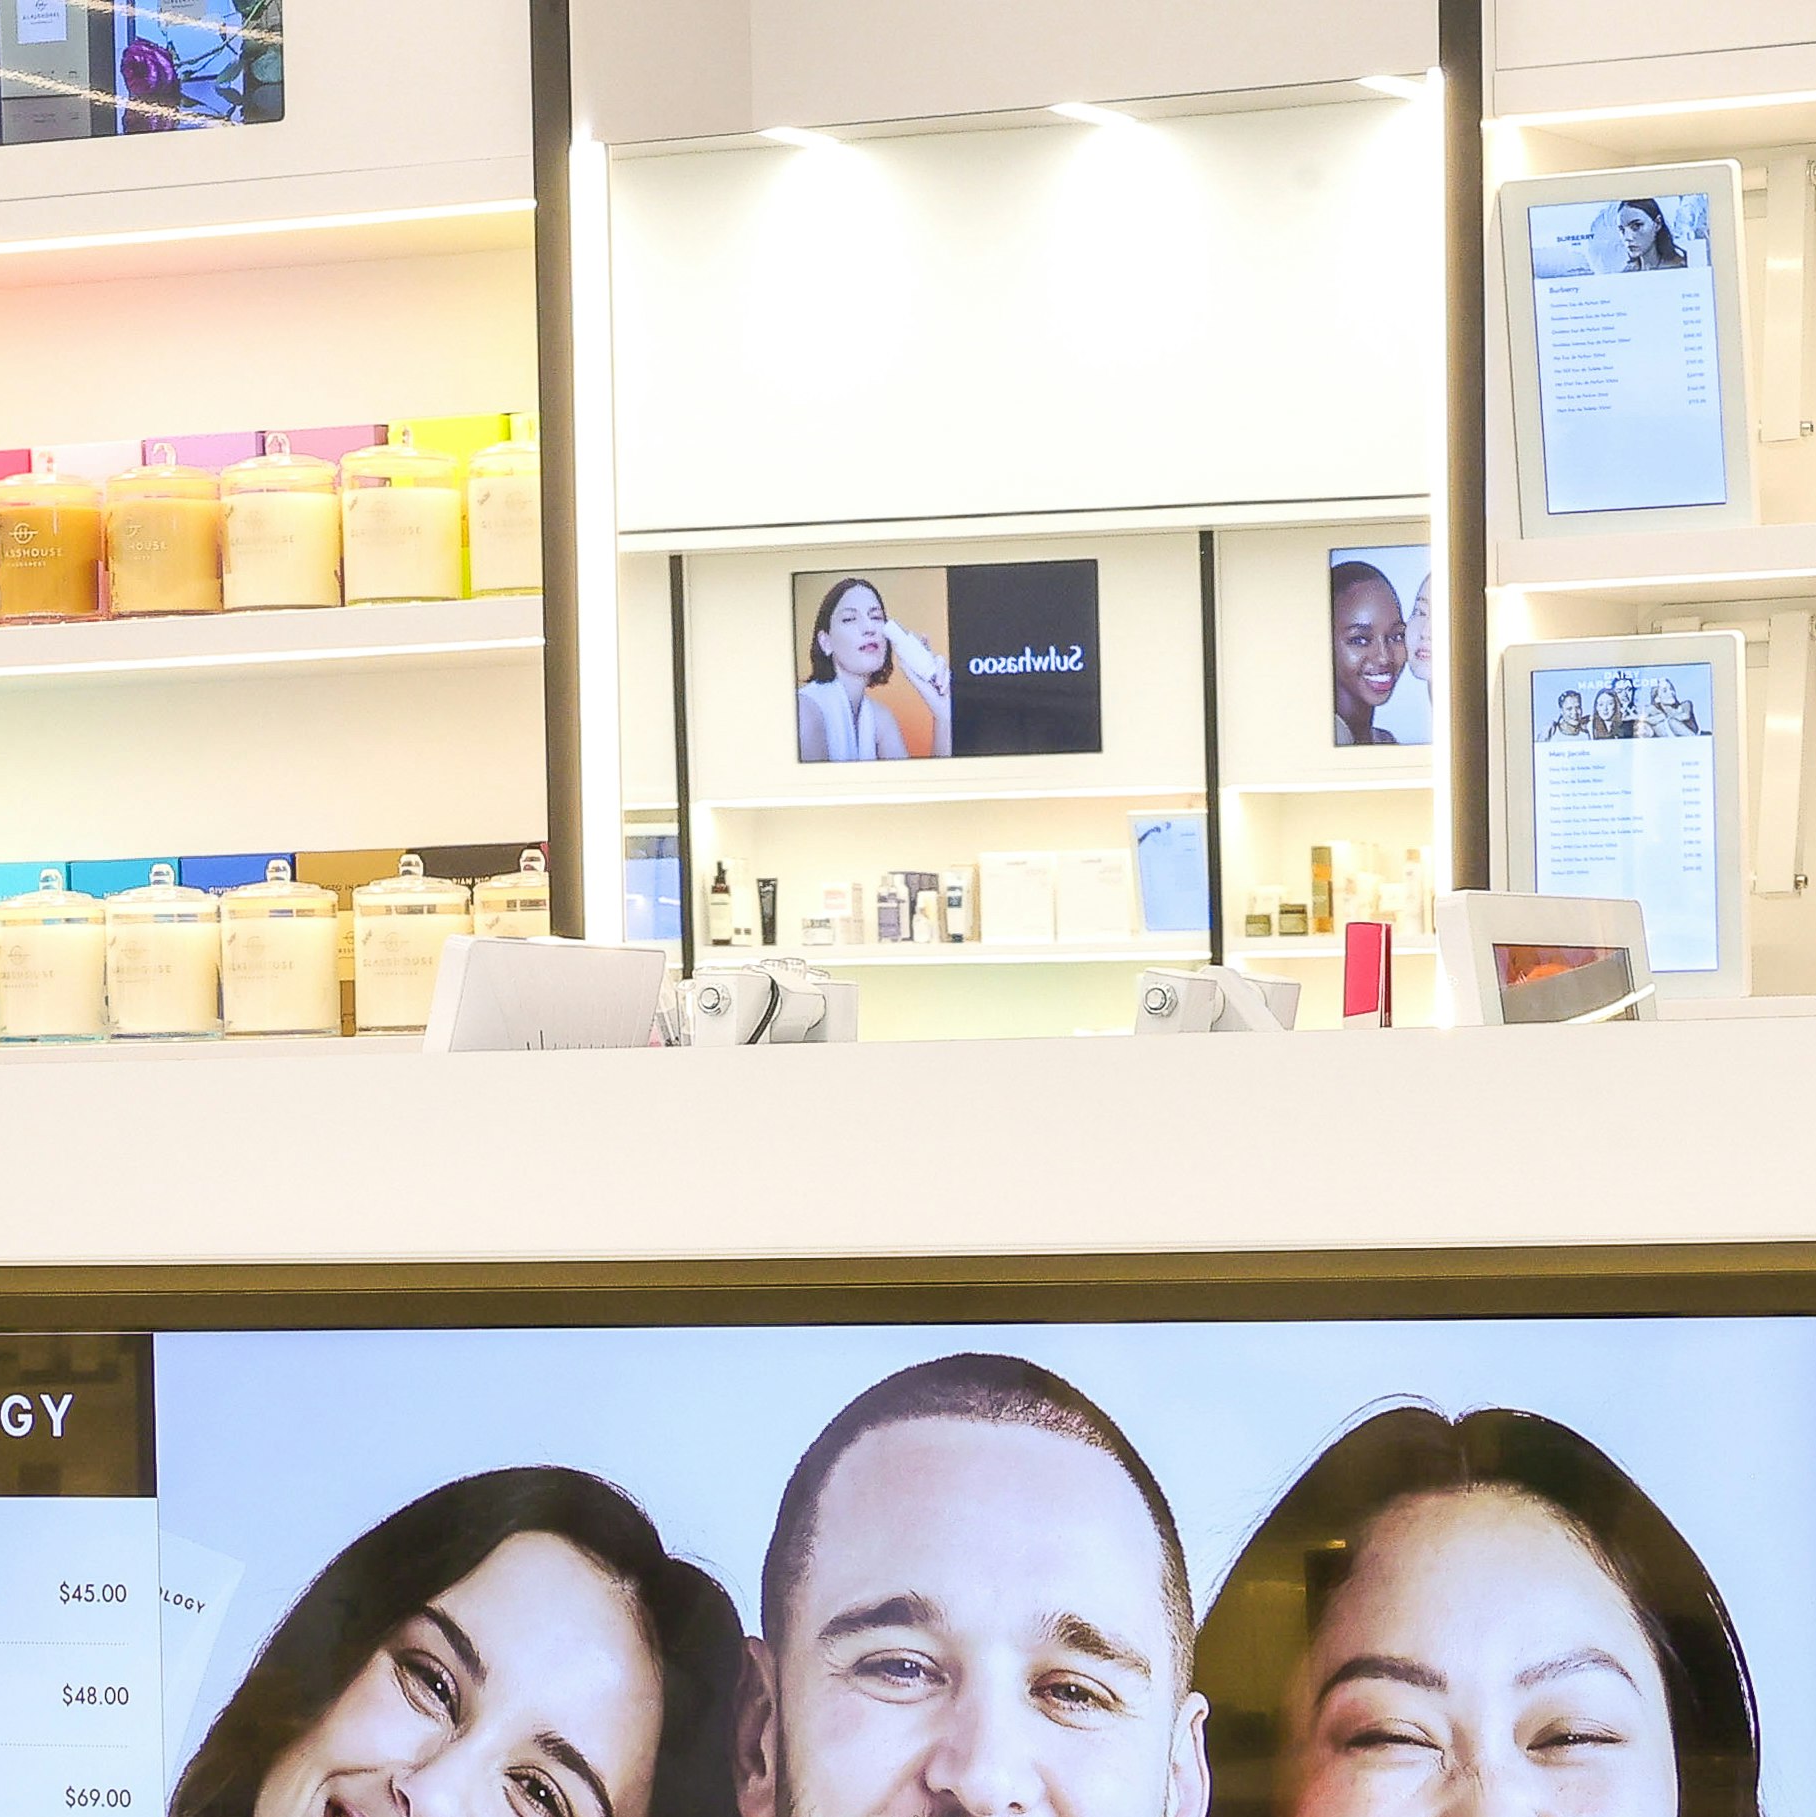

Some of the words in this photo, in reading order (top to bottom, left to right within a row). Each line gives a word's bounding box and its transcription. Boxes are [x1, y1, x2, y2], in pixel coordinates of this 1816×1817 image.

[1556, 232, 1595, 243] BURBERRY
[1604, 671, 1641, 680] DAISY
[59, 1582, 127, 1605] $45.00
[62, 1685, 130, 1707] $48.00
[65, 1787, 131, 1810] $69.00
